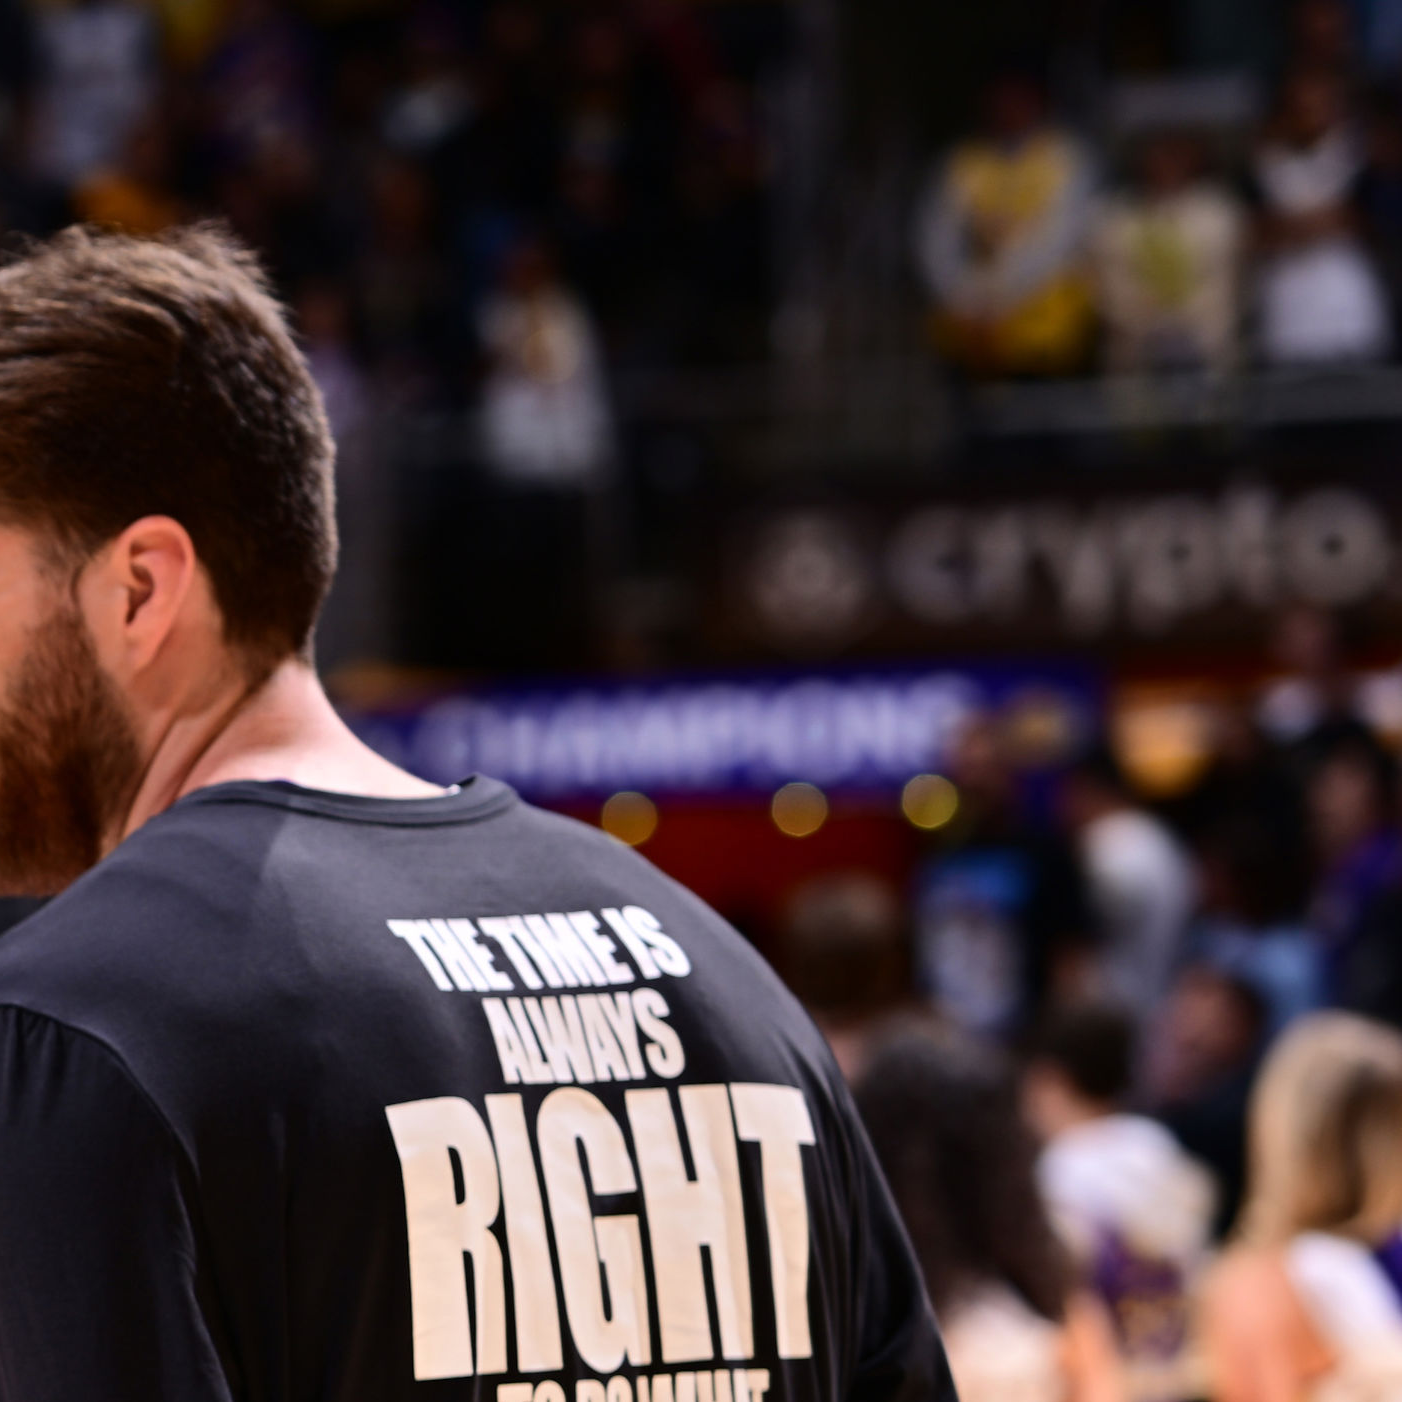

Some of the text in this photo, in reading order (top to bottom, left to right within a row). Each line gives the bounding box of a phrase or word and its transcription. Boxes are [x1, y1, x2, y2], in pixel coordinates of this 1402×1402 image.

[385, 905, 691, 993] THE TIME IS
[482, 988, 686, 1084] ALWAYS
[384, 1083, 816, 1381] RIGHT
